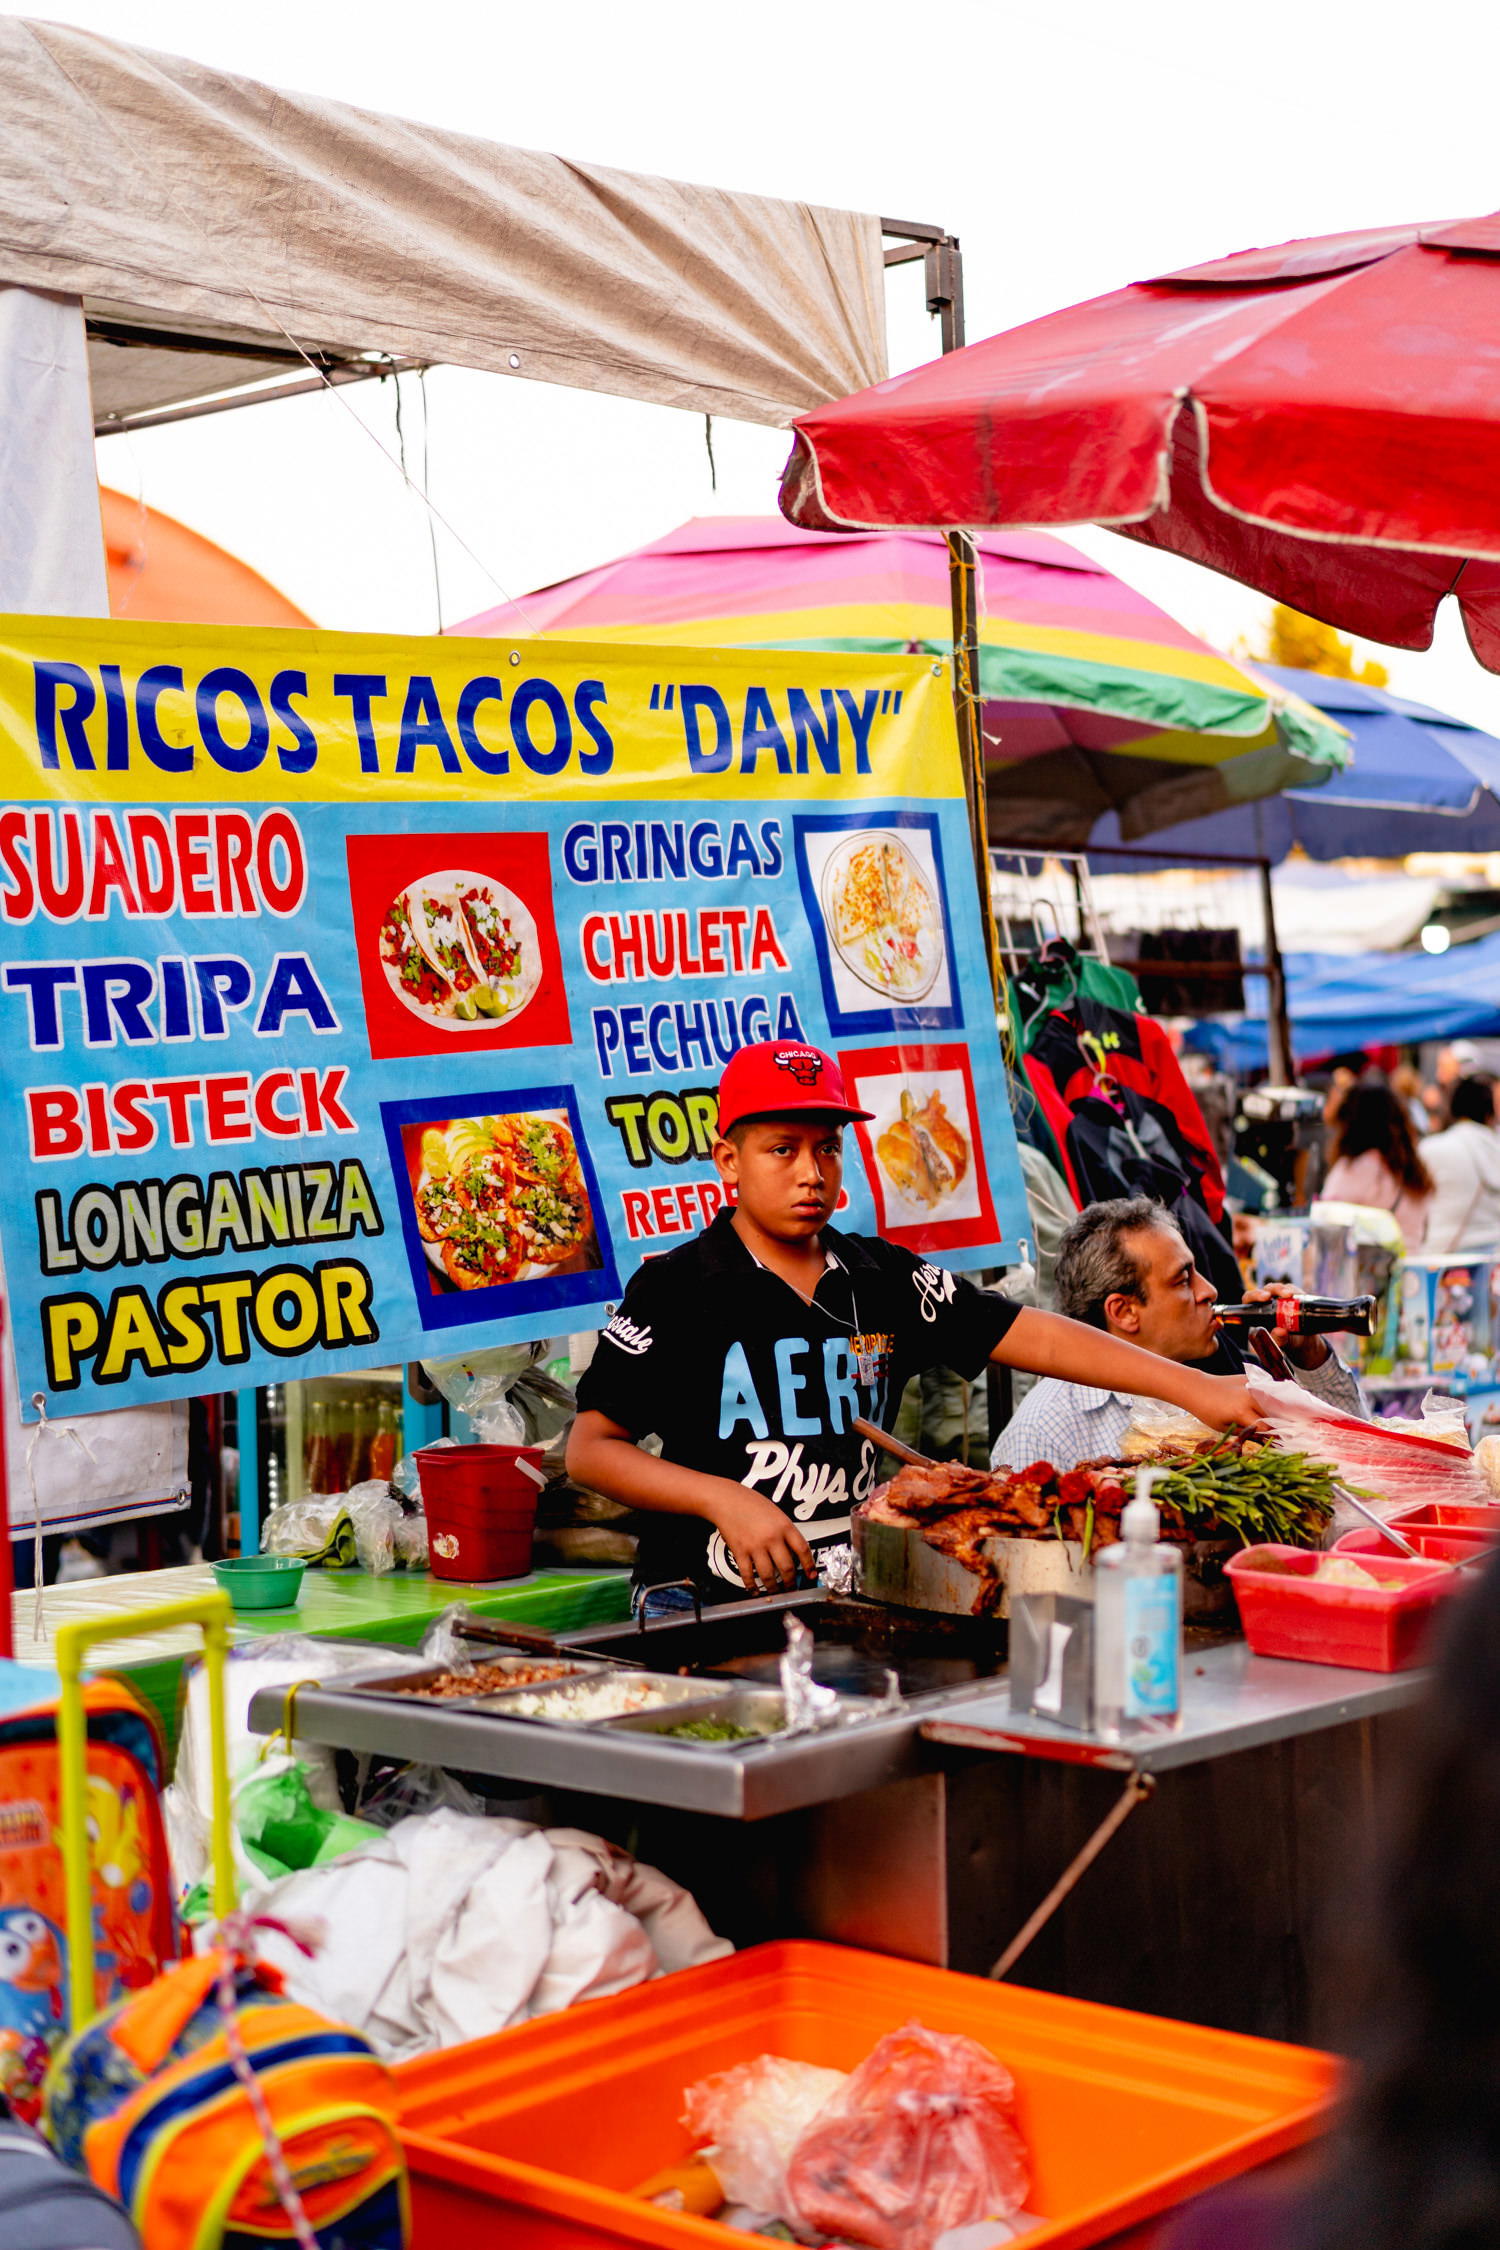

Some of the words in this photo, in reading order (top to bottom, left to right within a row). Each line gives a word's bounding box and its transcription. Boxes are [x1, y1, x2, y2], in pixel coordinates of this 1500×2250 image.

[34, 661, 318, 773] RICOS
[334, 674, 614, 775] TACOS
[649, 683, 903, 775] "DANY"
[0, 809, 306, 922] SUADERO
[564, 820, 783, 882] GRINGAS
[581, 907, 790, 983] CHULETA
[4, 954, 340, 1048] TRIPA
[592, 994, 810, 1078] PECHUGA
[779, 1050, 816, 1059] CHICAGO
[26, 1068, 358, 1160] BISTECK
[38, 1161, 382, 1273] LONGANIZA
[43, 1261, 376, 1388] PASTOR
[741, 1440, 849, 1520] Phys
